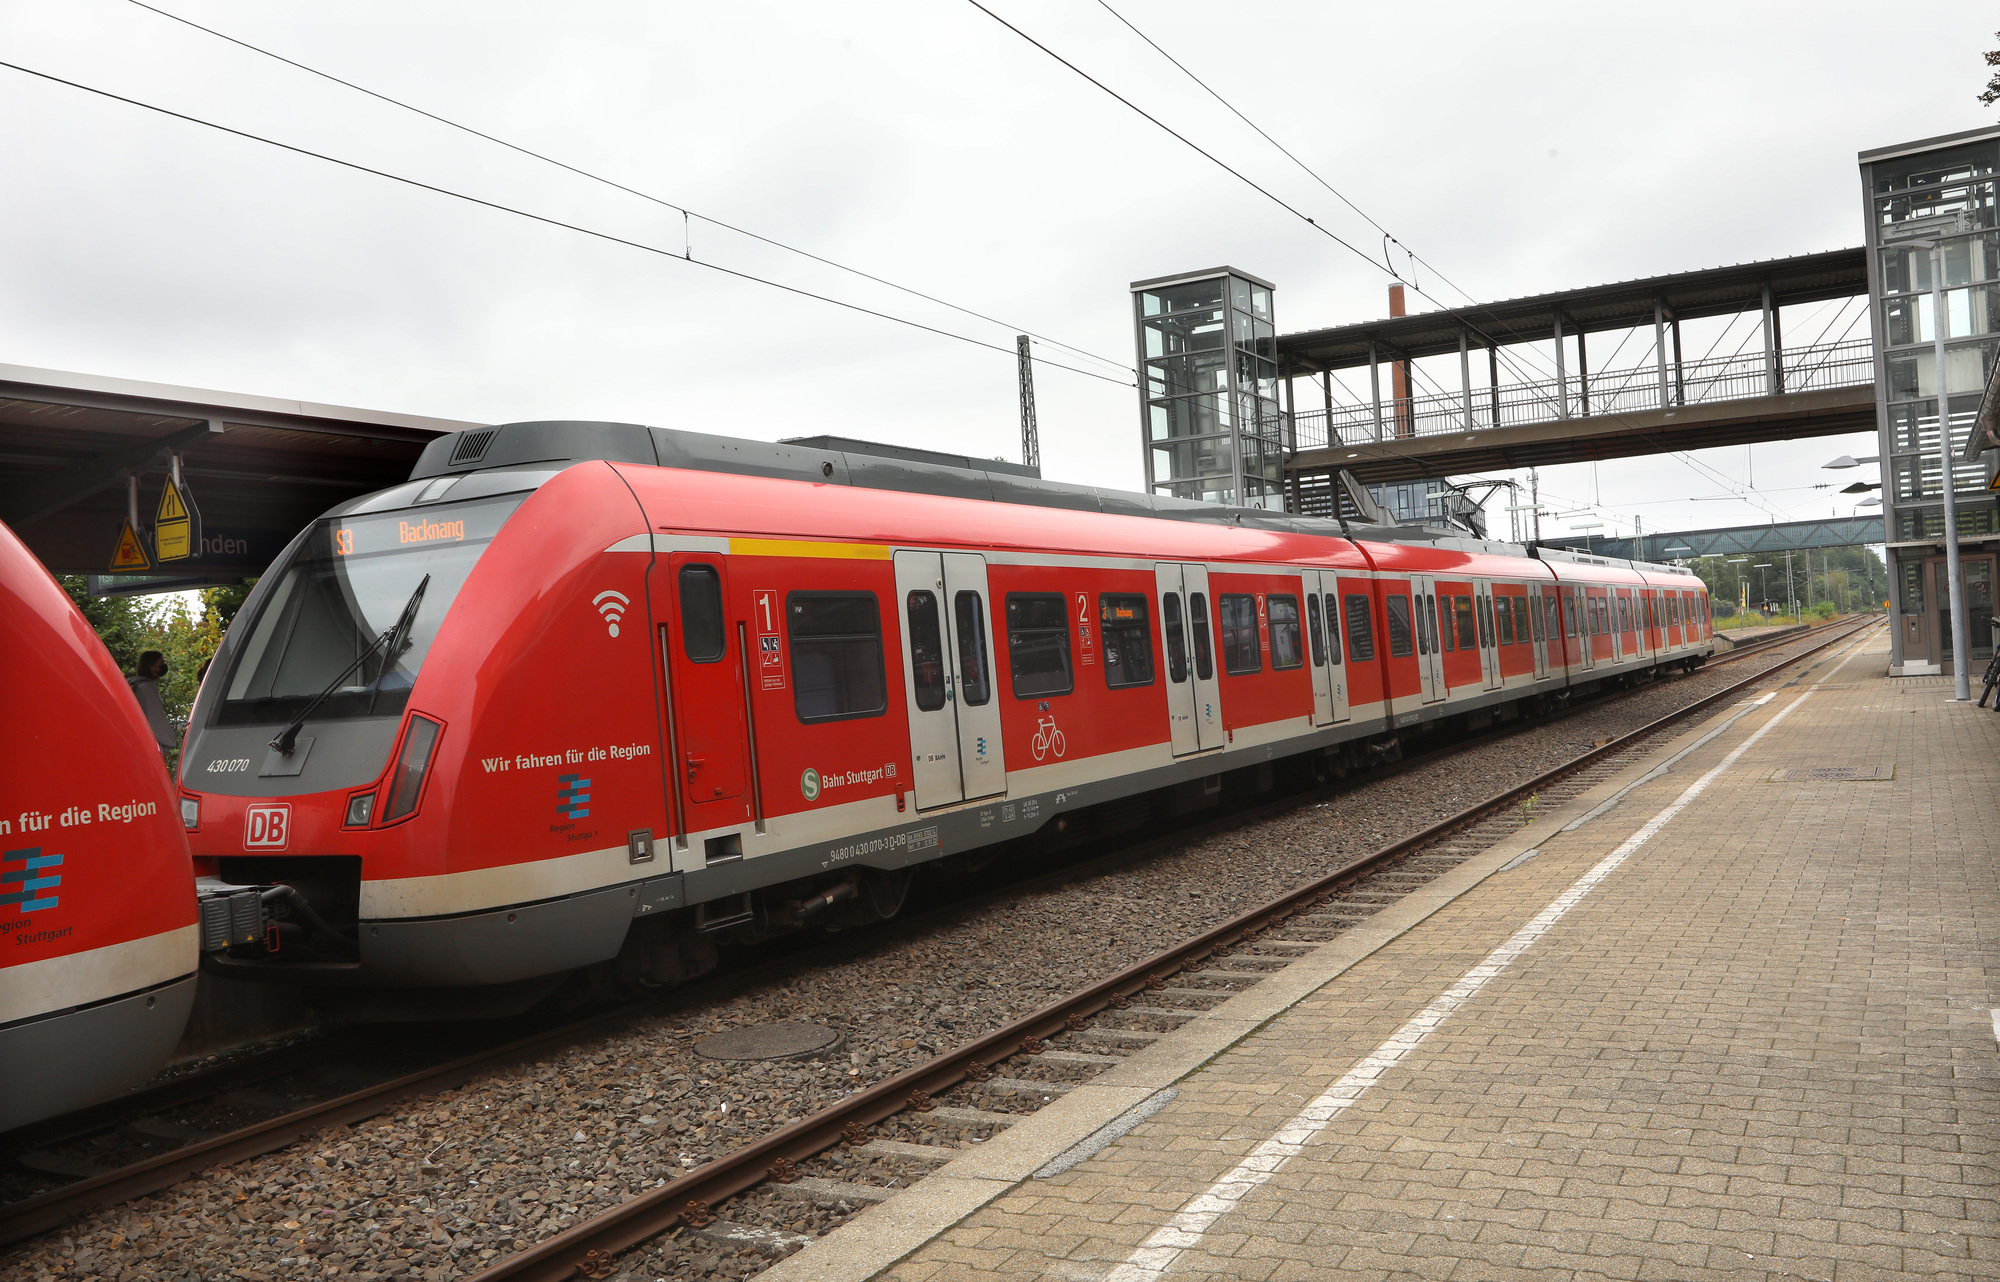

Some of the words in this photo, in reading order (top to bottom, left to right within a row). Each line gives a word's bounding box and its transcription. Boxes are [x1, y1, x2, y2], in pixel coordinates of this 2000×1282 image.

[336, 528, 354, 555] S3
[399, 518, 465, 544] Backnang
[759, 593, 772, 631] 1
[1078, 594, 1089, 622] 2
[1257, 595, 1265, 618] 2
[206, 759, 228, 773] 430
[228, 758, 250, 773] 070
[481, 756, 511, 773] Wir
[516, 753, 562, 770] fahren
[566, 749, 584, 764] für
[588, 746, 607, 761] die
[610, 743, 651, 760] Region
[803, 769, 819, 799] S
[822, 773, 845, 789] Bahn
[846, 766, 884, 785] Stuttgart
[885, 763, 896, 778] DB
[18, 811, 53, 833] für
[60, 806, 92, 828] die
[98, 799, 157, 824] Region
[247, 808, 289, 846] DB
[550, 822, 576, 834] Region
[567, 830, 599, 842] Stuttgat
[830, 846, 849, 862] 9480
[855, 842, 869, 856] 430
[869, 837, 889, 853] 070-3
[889, 833, 907, 851] D-DB
[15, 926, 73, 946] Stuttgart
